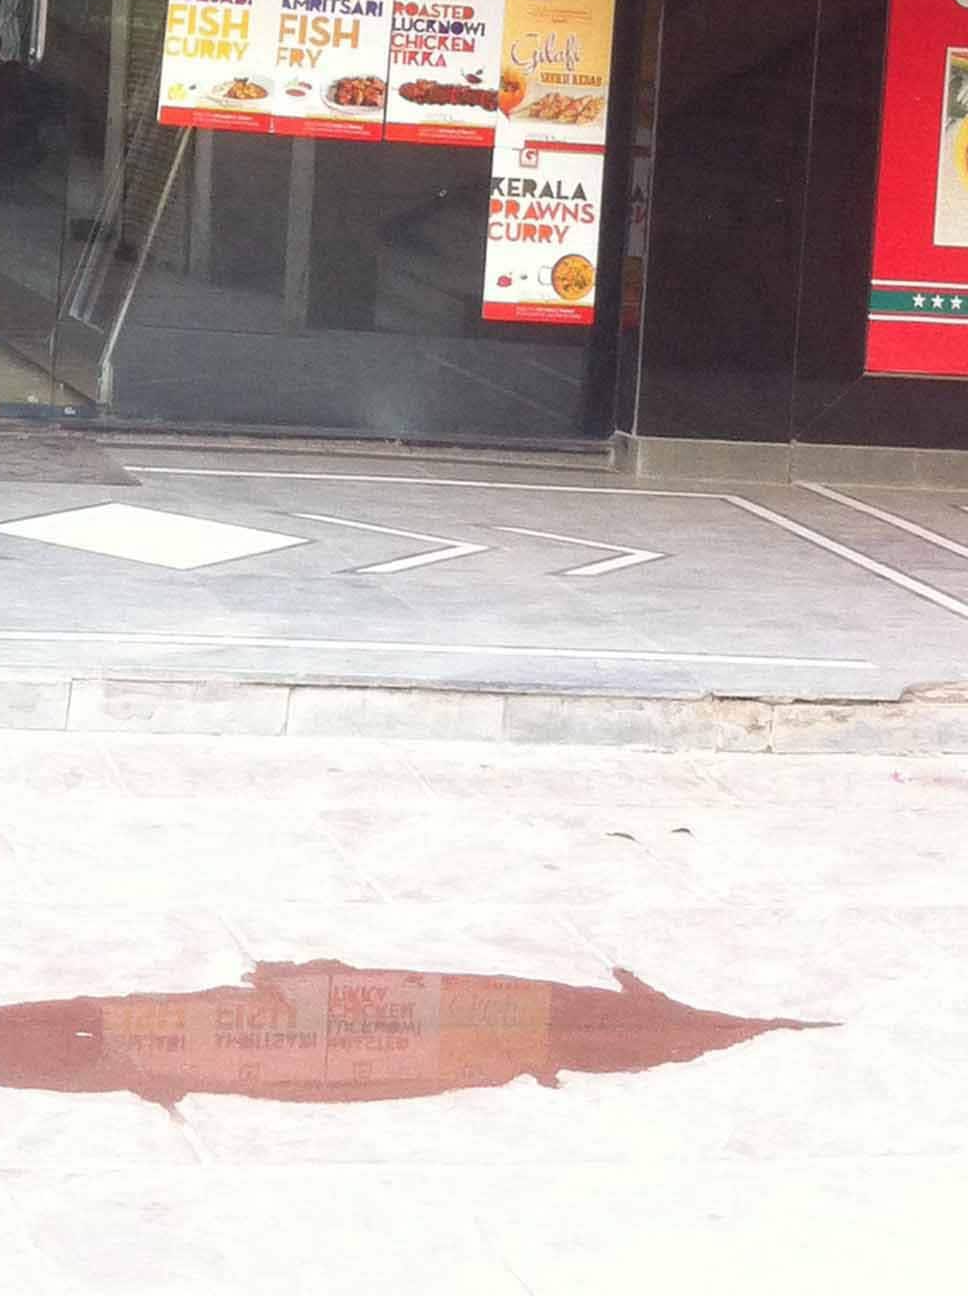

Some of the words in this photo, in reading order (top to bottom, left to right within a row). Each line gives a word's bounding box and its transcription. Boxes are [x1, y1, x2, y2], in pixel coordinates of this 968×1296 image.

[167, 5, 251, 40] FISH
[393, 1, 474, 21] ROASTED
[279, 13, 361, 49] FISH
[391, 16, 486, 37] LUCKNOWI
[166, 37, 249, 61] CURRY
[390, 33, 476, 53] CHICKEN
[276, 47, 323, 68] FRY
[390, 49, 447, 68] TIKKA
[490, 176, 587, 201] KERALA
[489, 198, 595, 224] PRAWNS
[487, 221, 570, 244] CURRY
